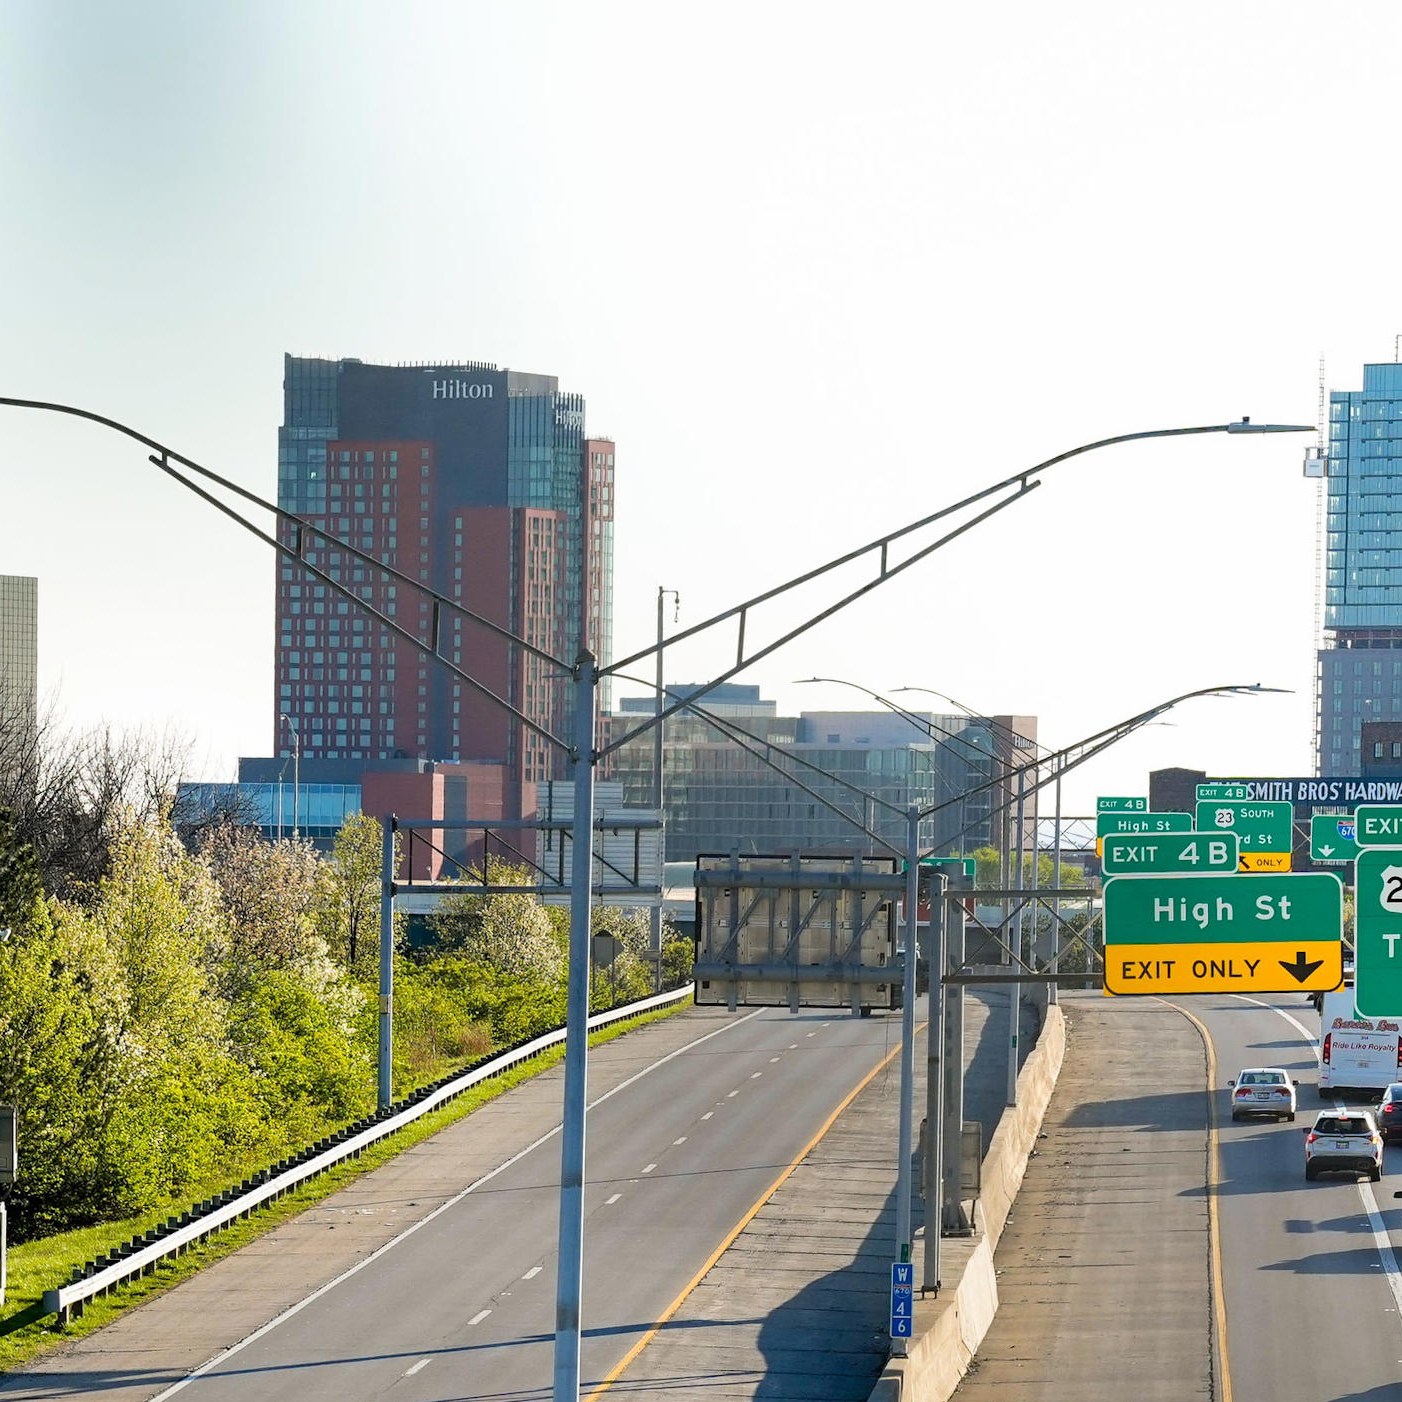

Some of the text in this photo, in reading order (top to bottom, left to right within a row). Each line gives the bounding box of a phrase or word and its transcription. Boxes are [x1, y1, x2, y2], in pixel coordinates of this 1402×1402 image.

[432, 379, 494, 399] Hilton
[555, 409, 583, 427] Hilton
[1200, 789, 1218, 797] EXIT
[1247, 782, 1293, 800] SMITH
[1217, 808, 1274, 824] 23 SOUTH
[1118, 820, 1171, 833] High St
[1258, 834, 1272, 844] St
[1112, 847, 1158, 863] EXIT
[1256, 859, 1283, 867] ONLY
[1153, 895, 1292, 929] High St
[1121, 959, 1261, 980] EXIT ONLY
[1332, 1041, 1396, 1052] Ride Like Royalty
[898, 1267, 908, 1282] W
[896, 1302, 905, 1315] 4
[898, 1320, 905, 1333] 6
